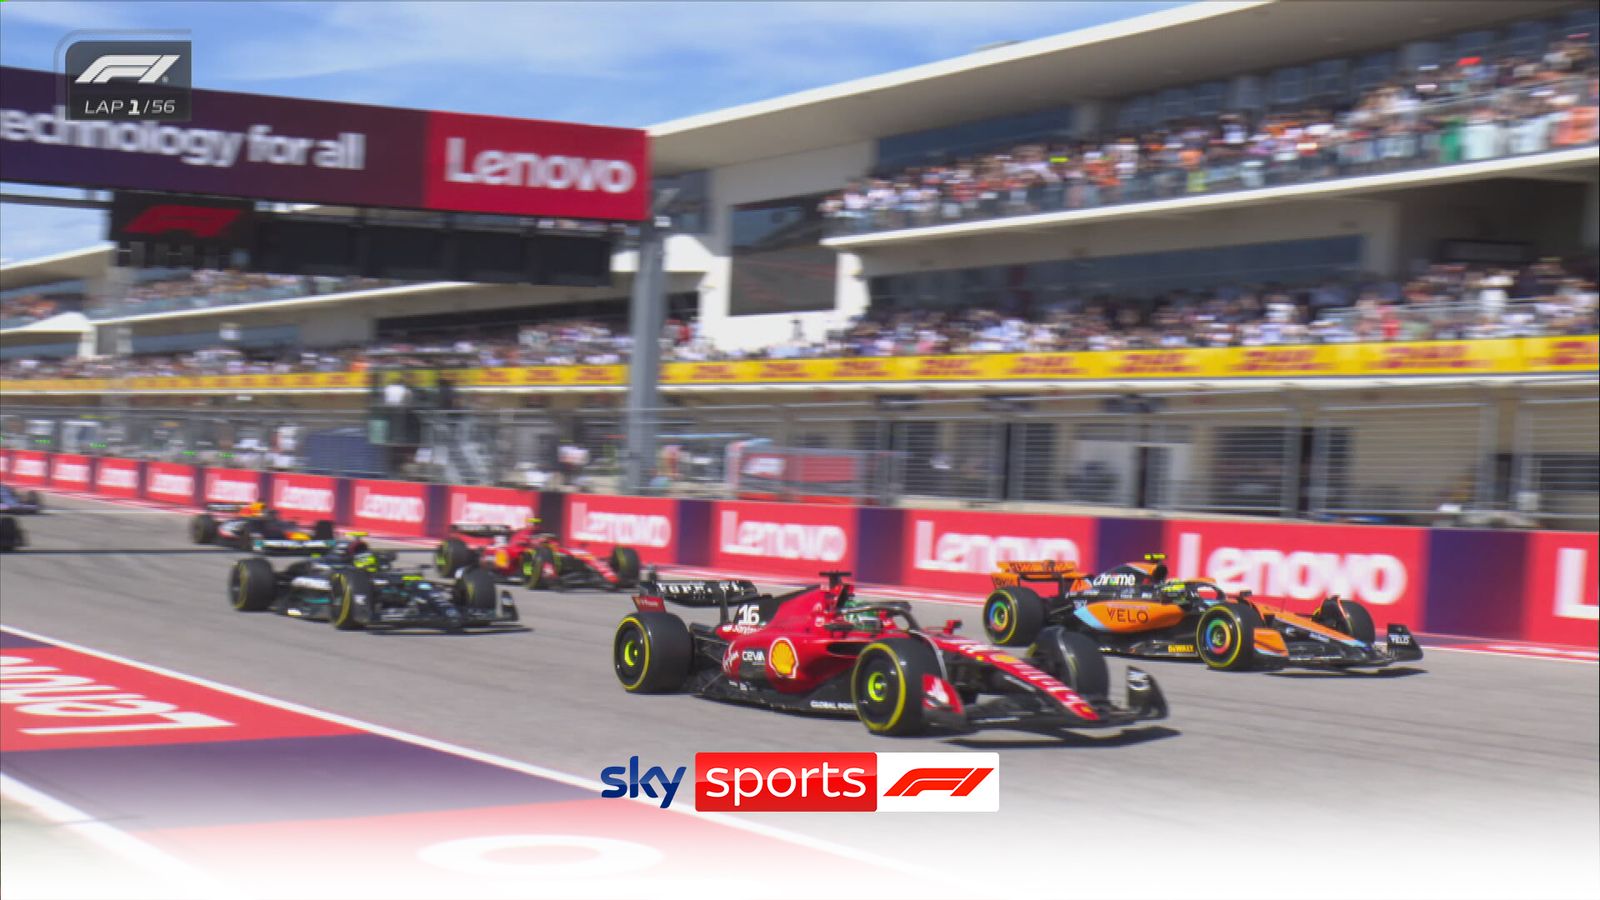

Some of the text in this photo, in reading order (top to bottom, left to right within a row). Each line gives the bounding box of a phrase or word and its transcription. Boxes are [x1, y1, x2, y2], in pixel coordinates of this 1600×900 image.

[247, 124, 309, 165] for
[314, 133, 366, 170] all
[446, 137, 635, 194] Lenovo
[571, 502, 671, 547] Lenovo
[720, 510, 847, 561] Lenovo
[914, 520, 1079, 574] Lenovo
[1178, 533, 1407, 604] Lenovo
[738, 604, 761, 626] 16
[1107, 607, 1149, 624] VELO
